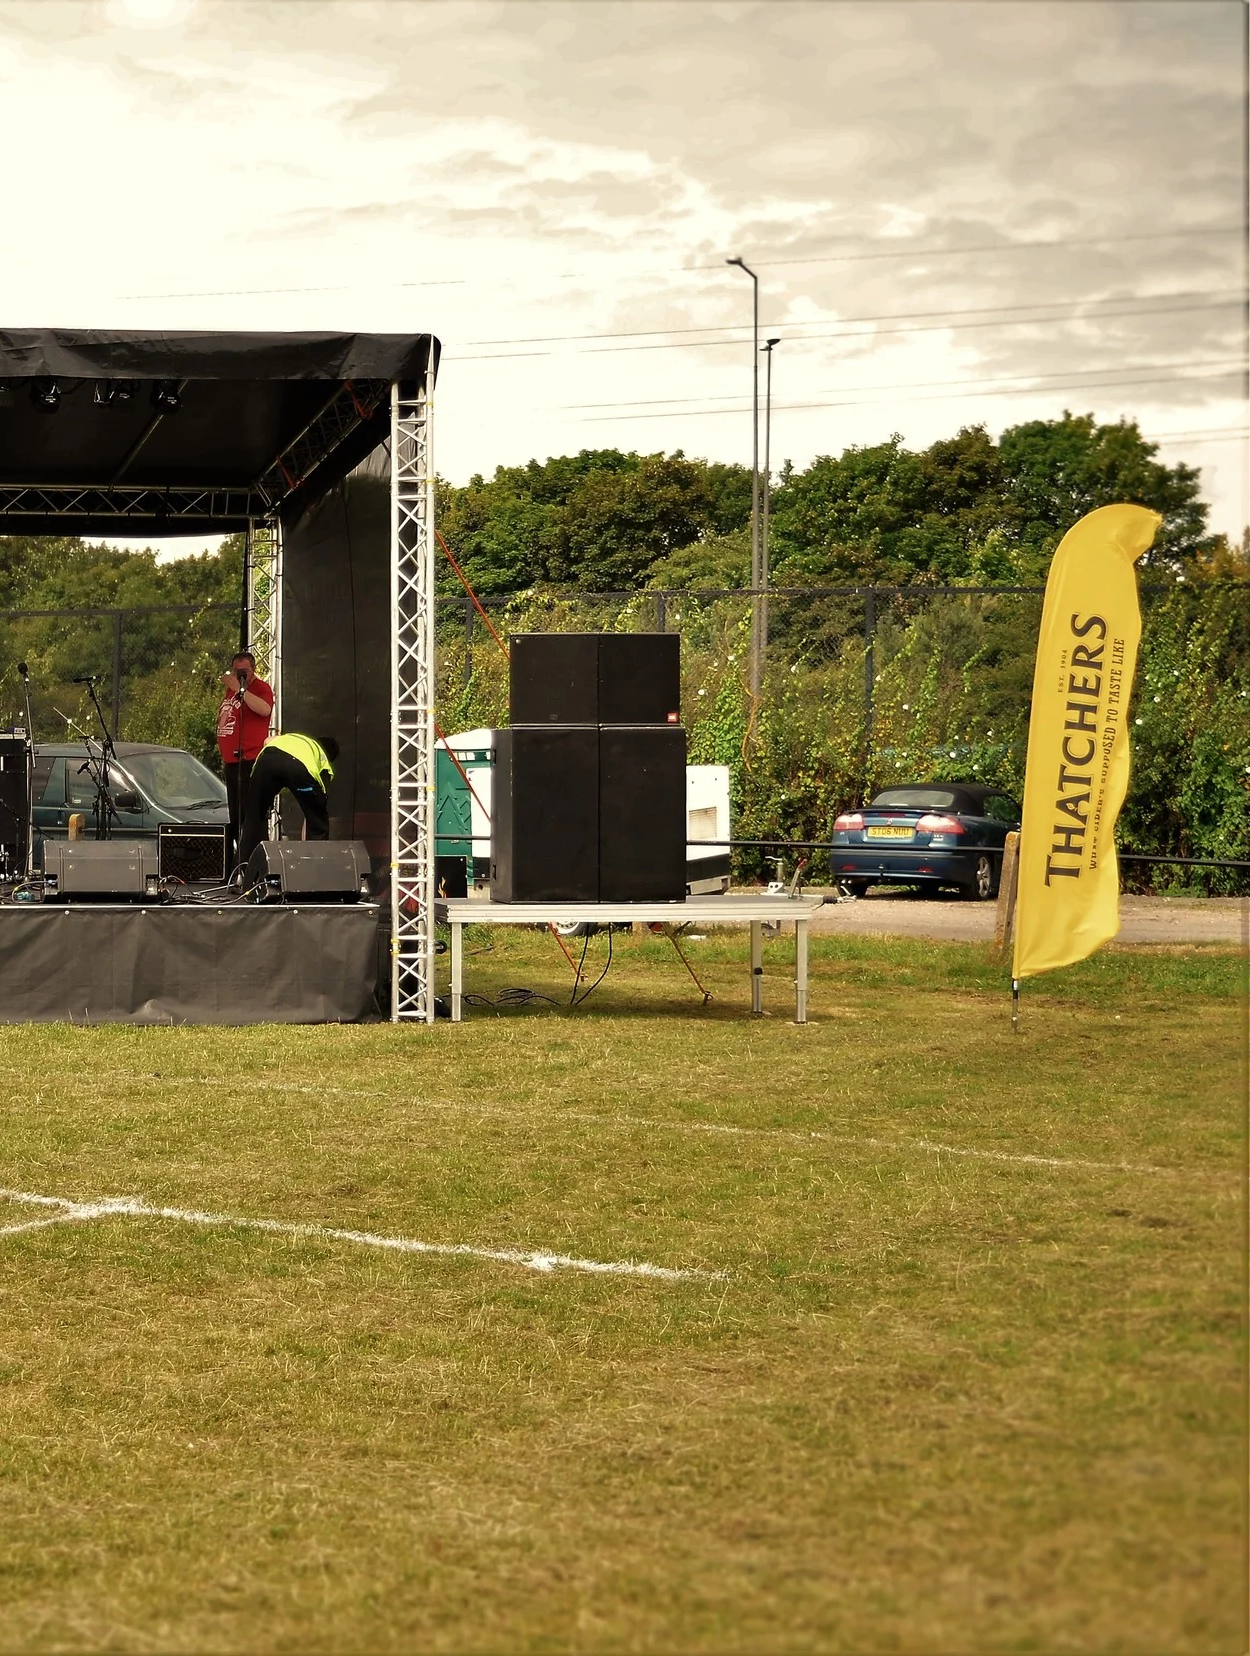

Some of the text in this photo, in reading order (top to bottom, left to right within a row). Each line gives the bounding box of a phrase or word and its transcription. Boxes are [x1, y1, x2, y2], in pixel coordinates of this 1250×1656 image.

[1112, 638, 1125, 665] LIKE
[1108, 669, 1123, 704] TASTE
[1106, 708, 1119, 722] TO
[1044, 613, 1107, 887] THATCHERS
[1100, 727, 1117, 784] SUPPOSED
